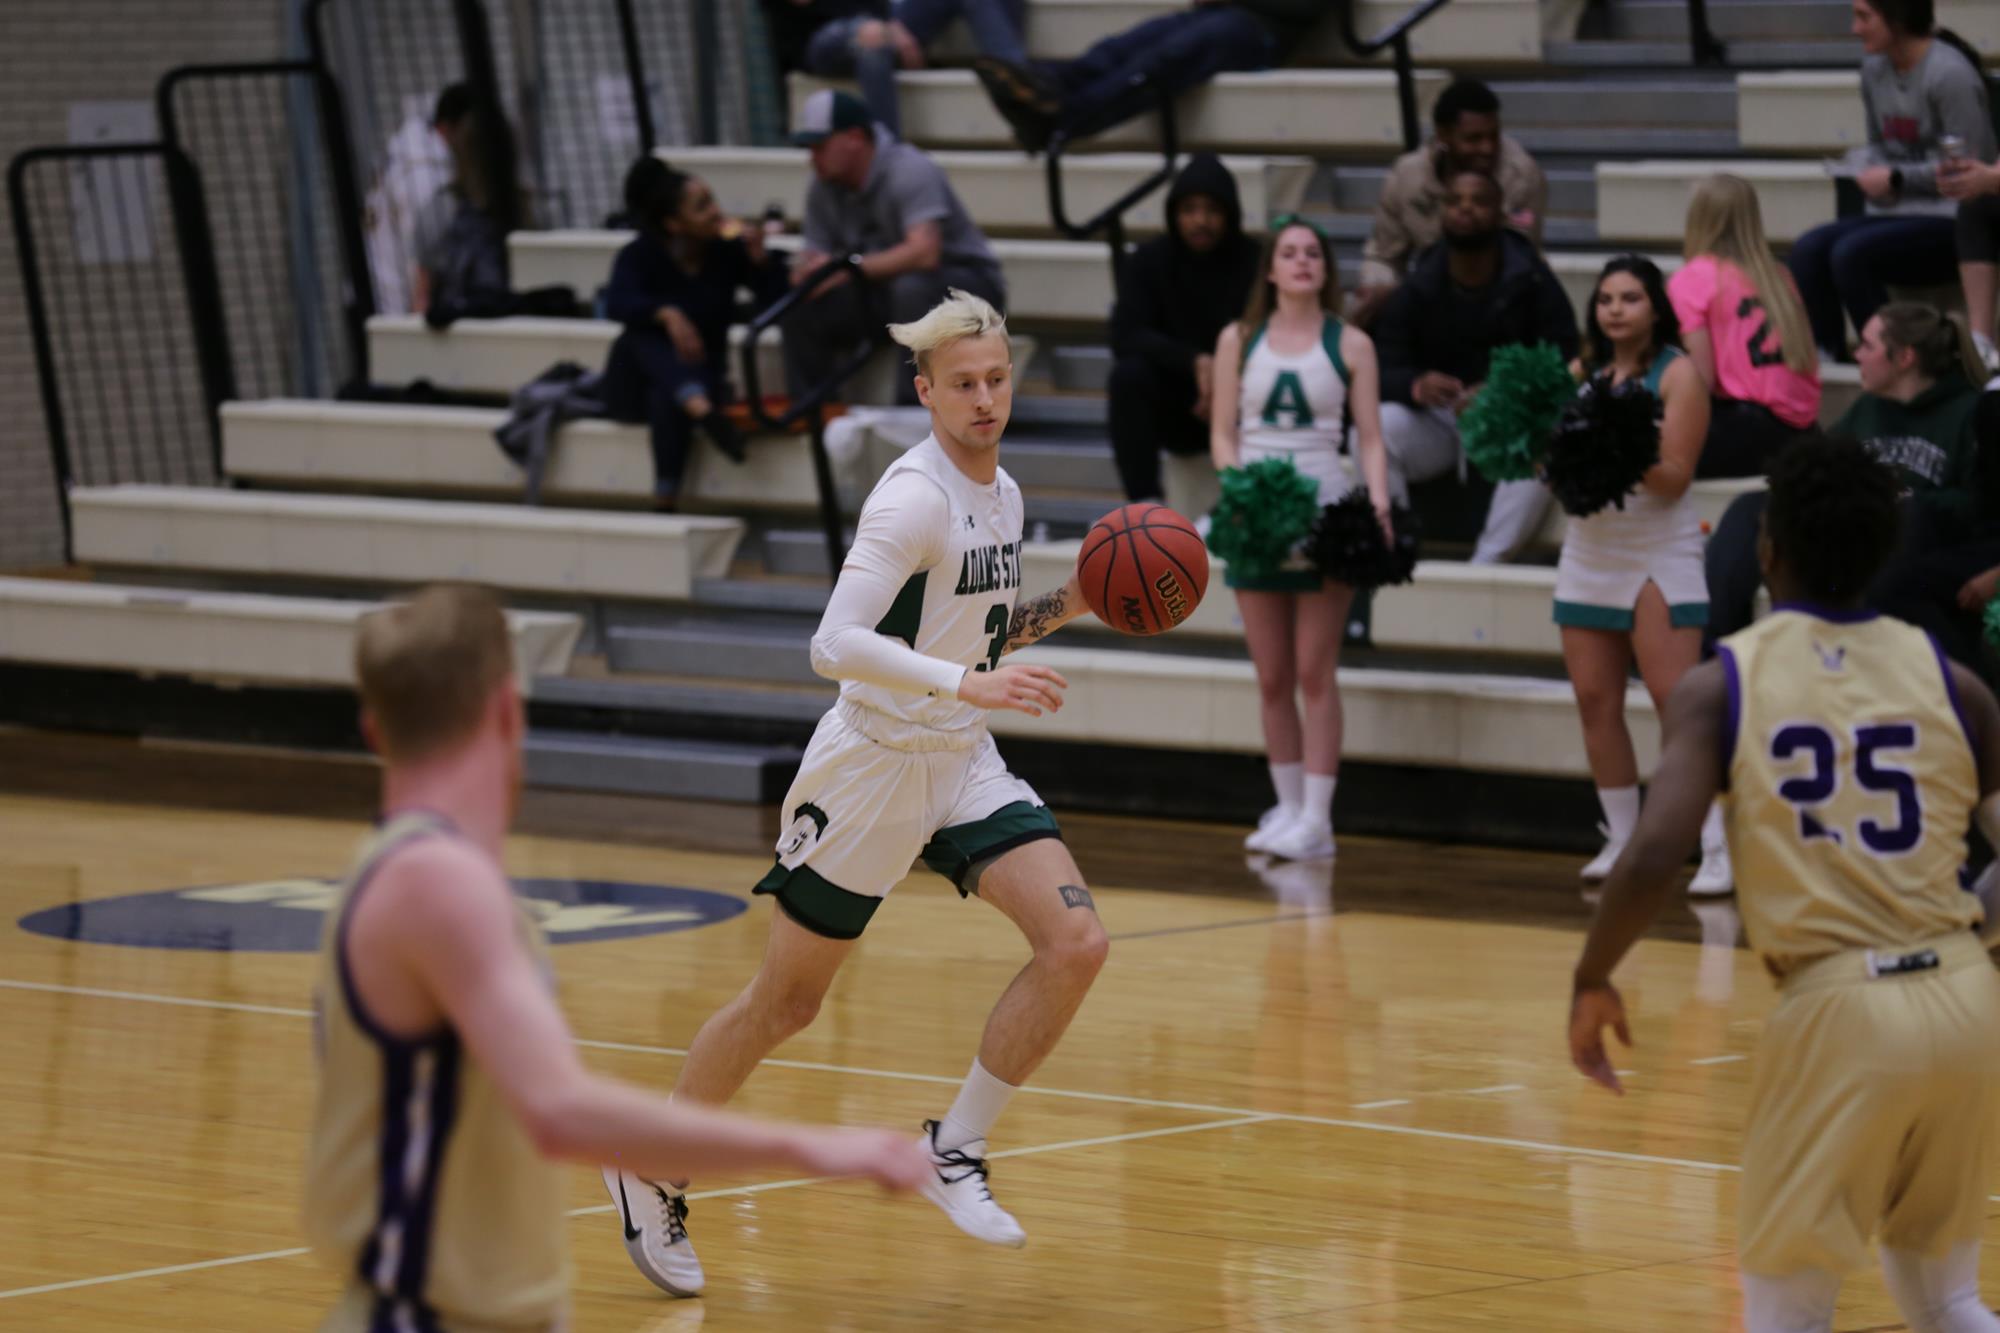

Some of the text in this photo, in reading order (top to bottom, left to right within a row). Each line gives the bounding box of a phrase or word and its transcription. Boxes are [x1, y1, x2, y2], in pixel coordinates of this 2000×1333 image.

[1262, 369, 1314, 428] A
[954, 544, 1000, 595] ADAMS
[974, 603, 1009, 672] 3
[1771, 724, 1922, 855] 25
